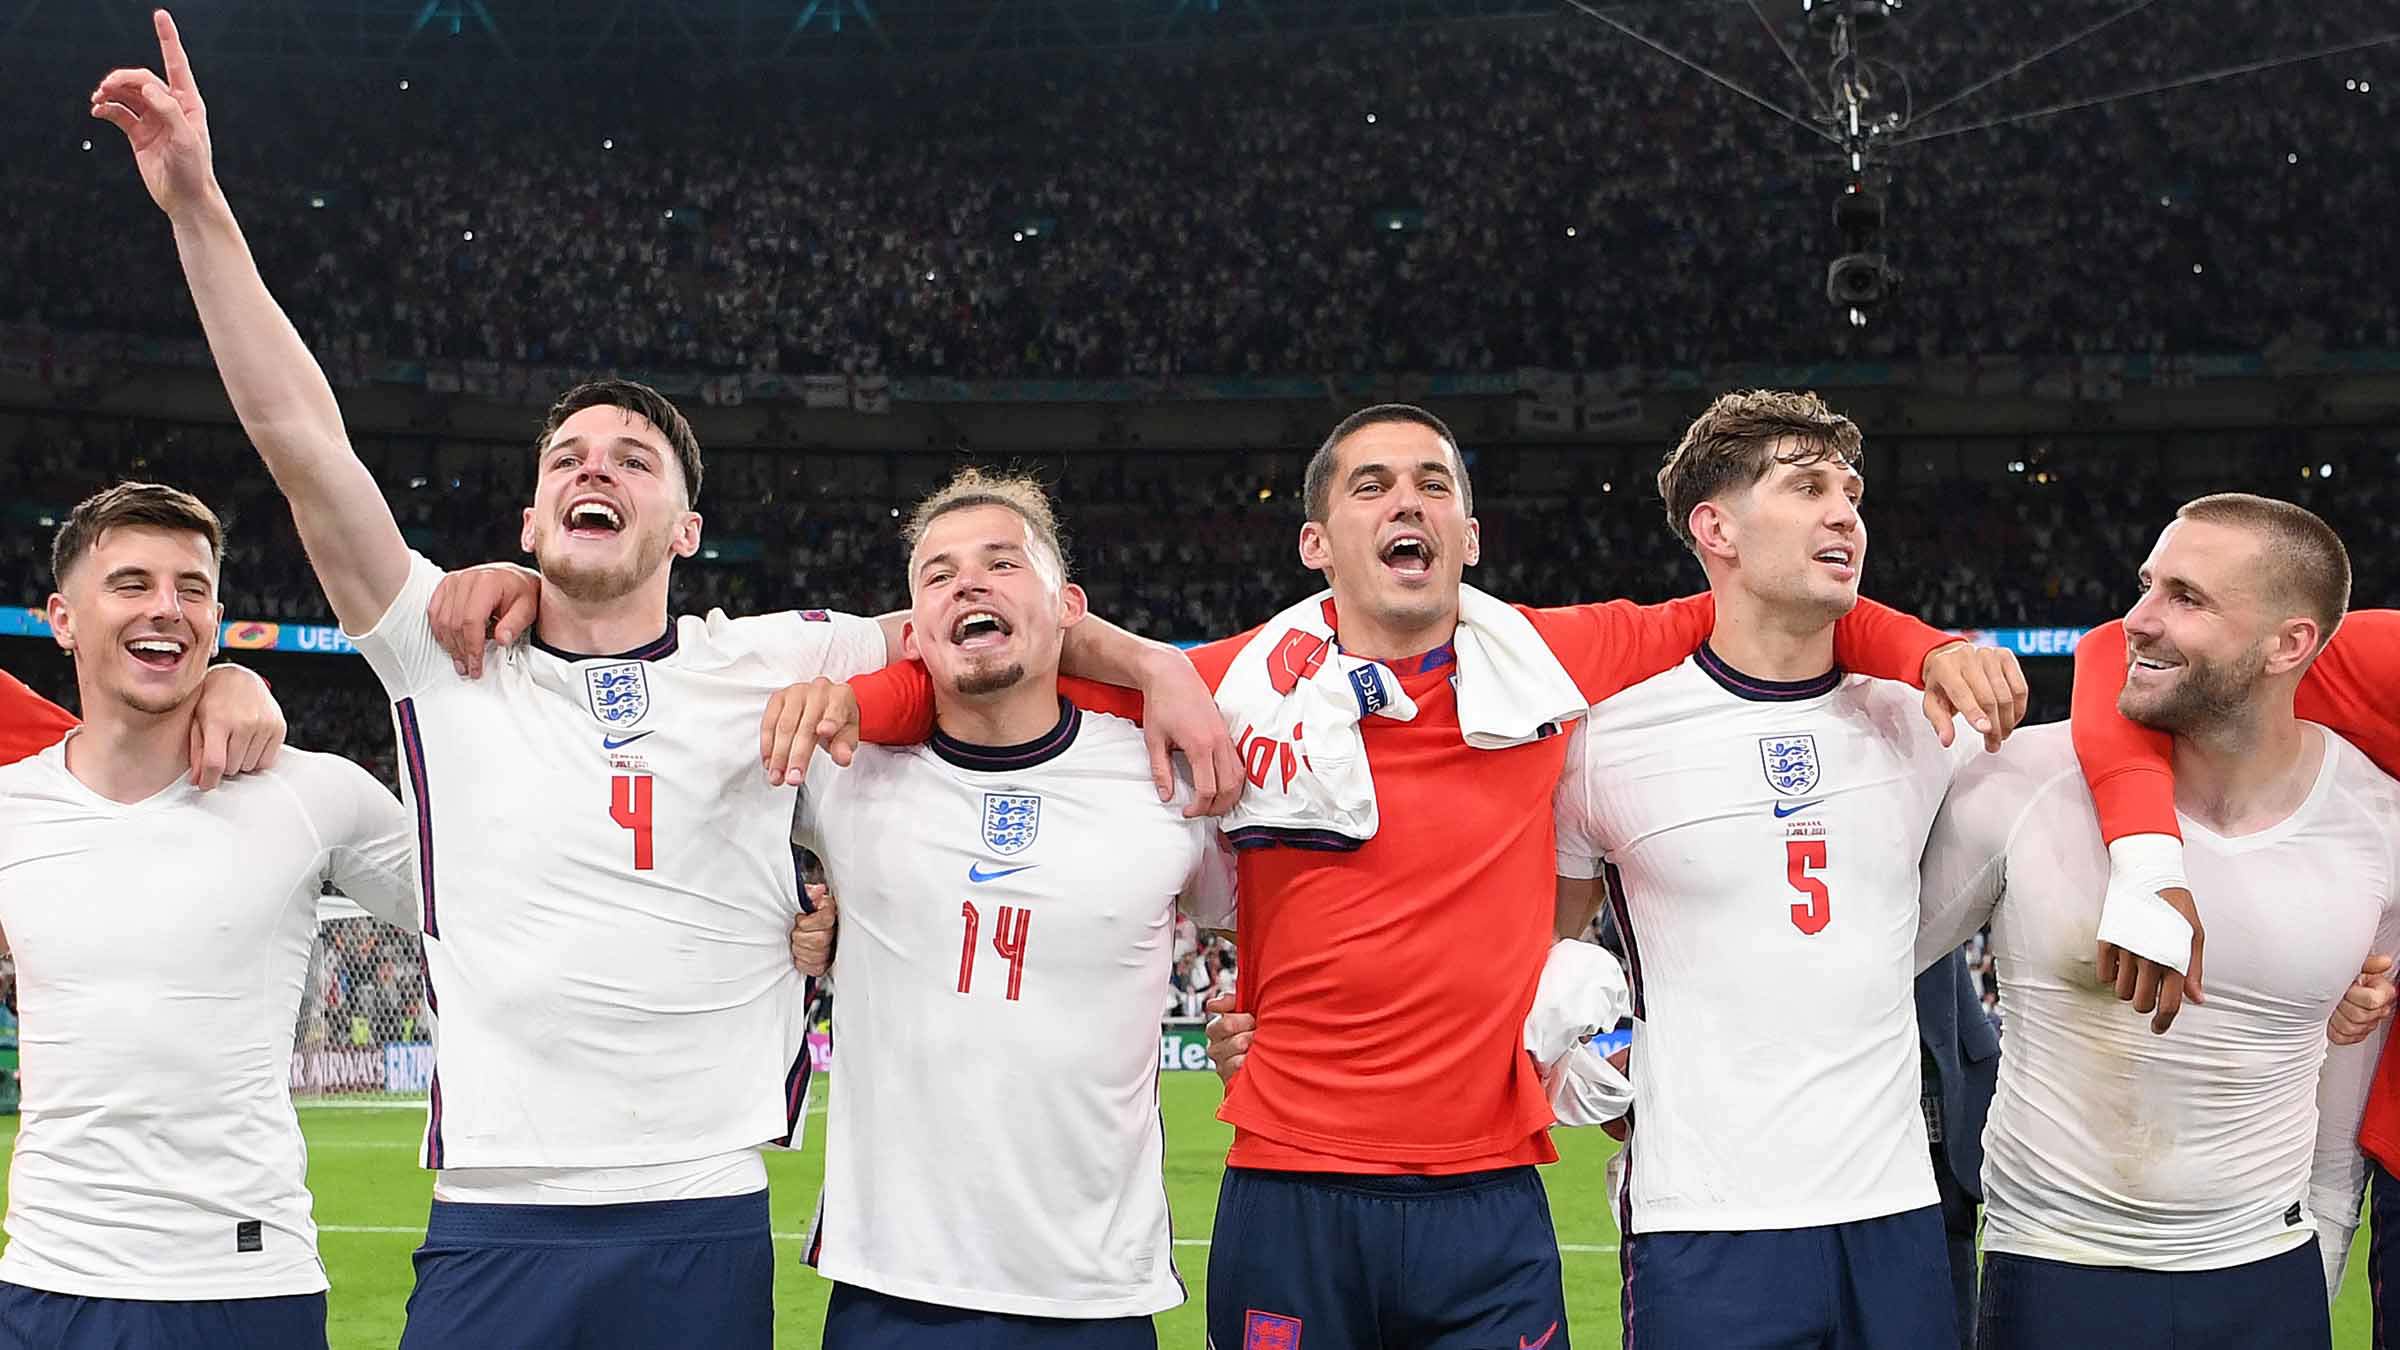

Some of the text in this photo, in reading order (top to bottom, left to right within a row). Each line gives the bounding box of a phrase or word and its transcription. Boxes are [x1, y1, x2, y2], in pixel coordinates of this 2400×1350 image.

[1356, 667, 1381, 713] SPECT
[609, 776, 653, 870] 4
[1786, 840, 1831, 935] 5
[957, 900, 1031, 1001] 14
[310, 1050, 384, 1088] AIRWAYS
[1161, 1036, 1216, 1069] He
